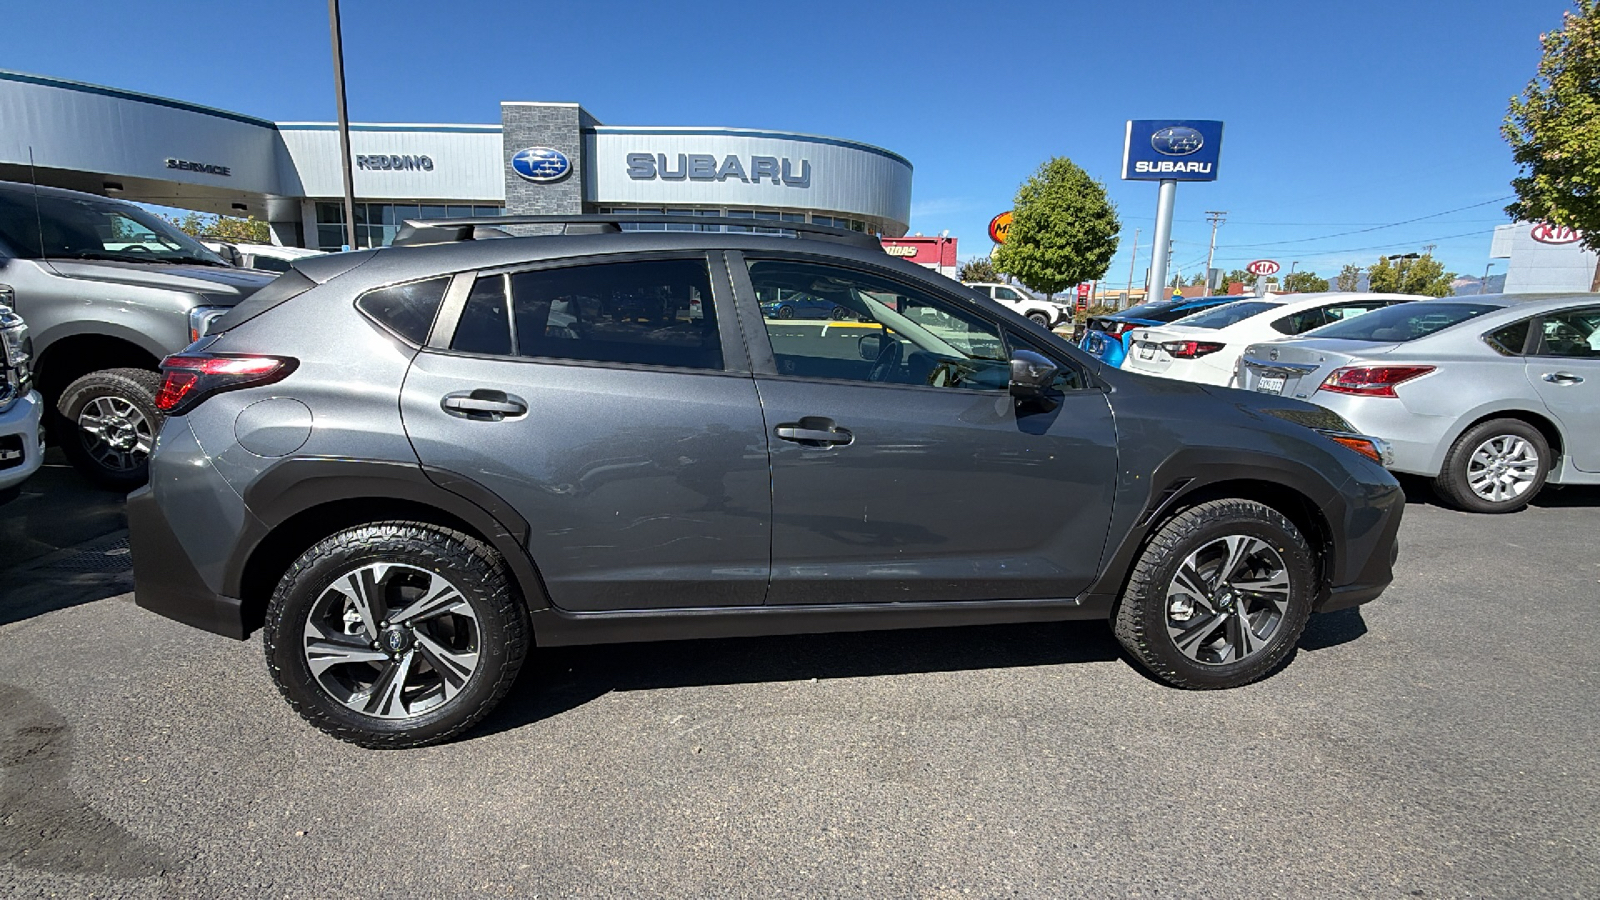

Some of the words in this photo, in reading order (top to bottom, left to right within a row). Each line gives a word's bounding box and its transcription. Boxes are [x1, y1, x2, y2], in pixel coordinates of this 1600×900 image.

[165, 158, 231, 176] SERVICE
[356, 154, 434, 171] REDDING
[626, 152, 811, 188] SUBARU
[1135, 161, 1212, 173] SUBARU
[1540, 223, 1578, 240] KIA
[1254, 262, 1274, 274] KIA
